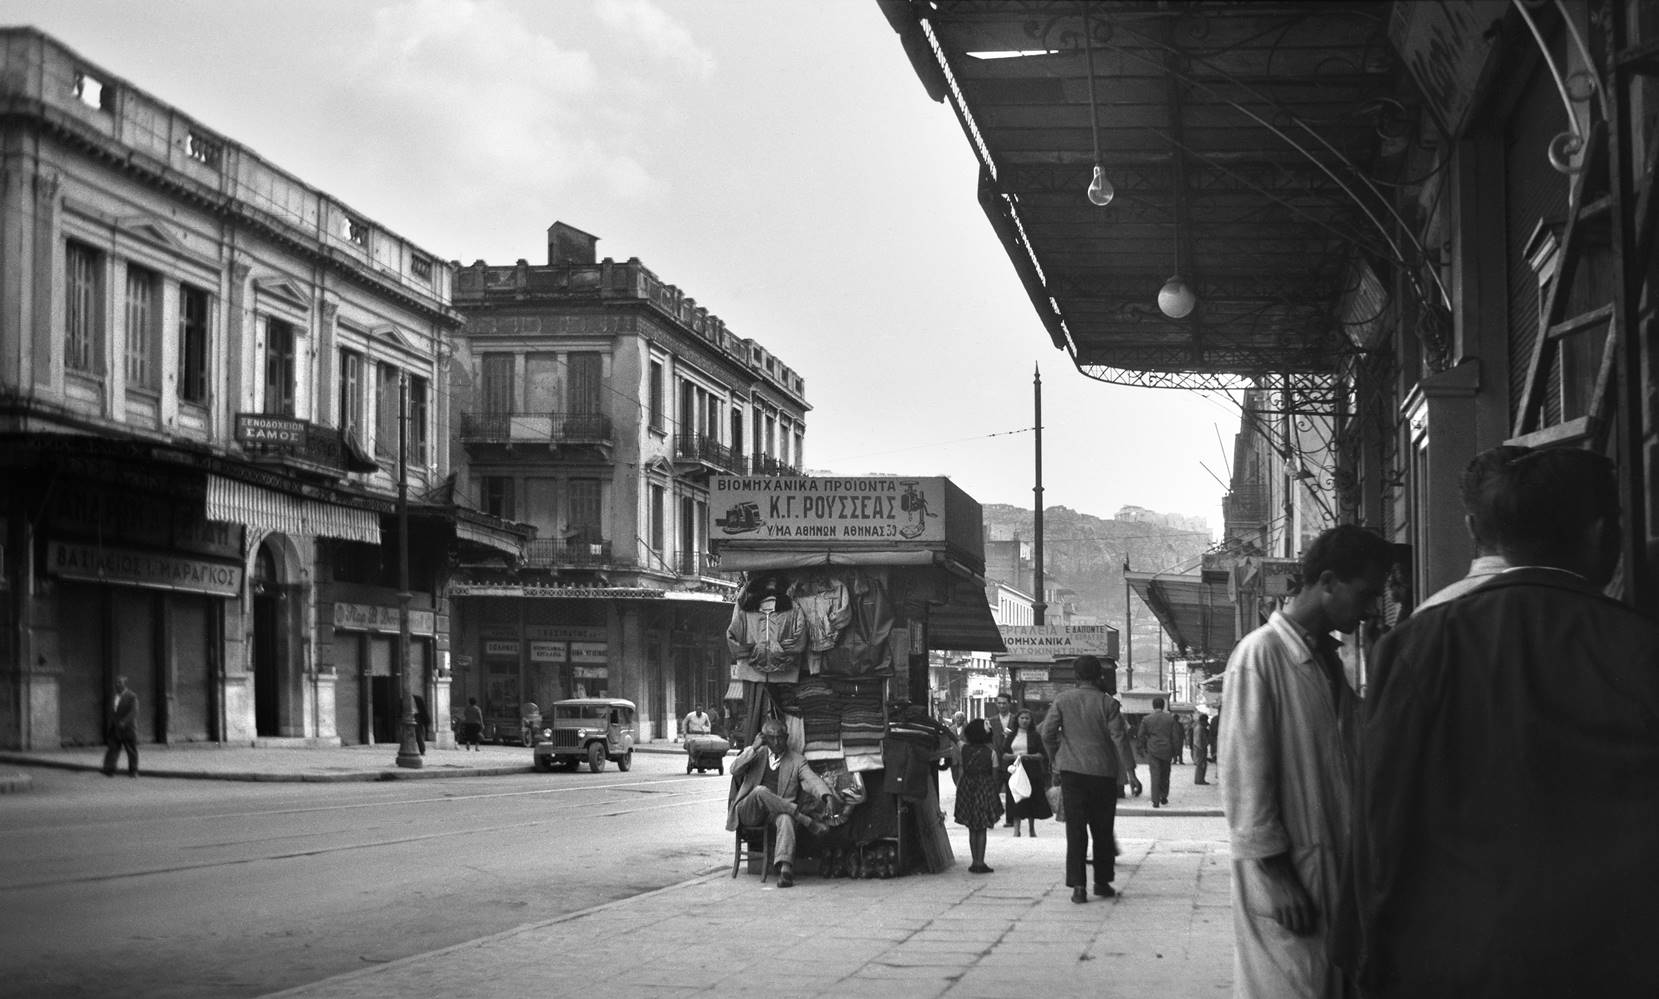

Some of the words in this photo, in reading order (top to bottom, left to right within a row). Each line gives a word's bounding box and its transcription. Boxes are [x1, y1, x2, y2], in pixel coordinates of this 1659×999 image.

[246, 427, 299, 441] ΣΑΜΟΣ
[718, 479, 818, 491] ΒΙΟΜΗΧΑΝΙΚΑ
[795, 525, 836, 537] ΑΘΗΝΩΝ
[843, 525, 885, 537] ΑΘΗΝΑΣ
[160, 560, 235, 586] ΜΑΡΑΓΚΟΣ
[1003, 637, 1071, 645] ΙΟΜΗΧΑΝΙΚΑ
